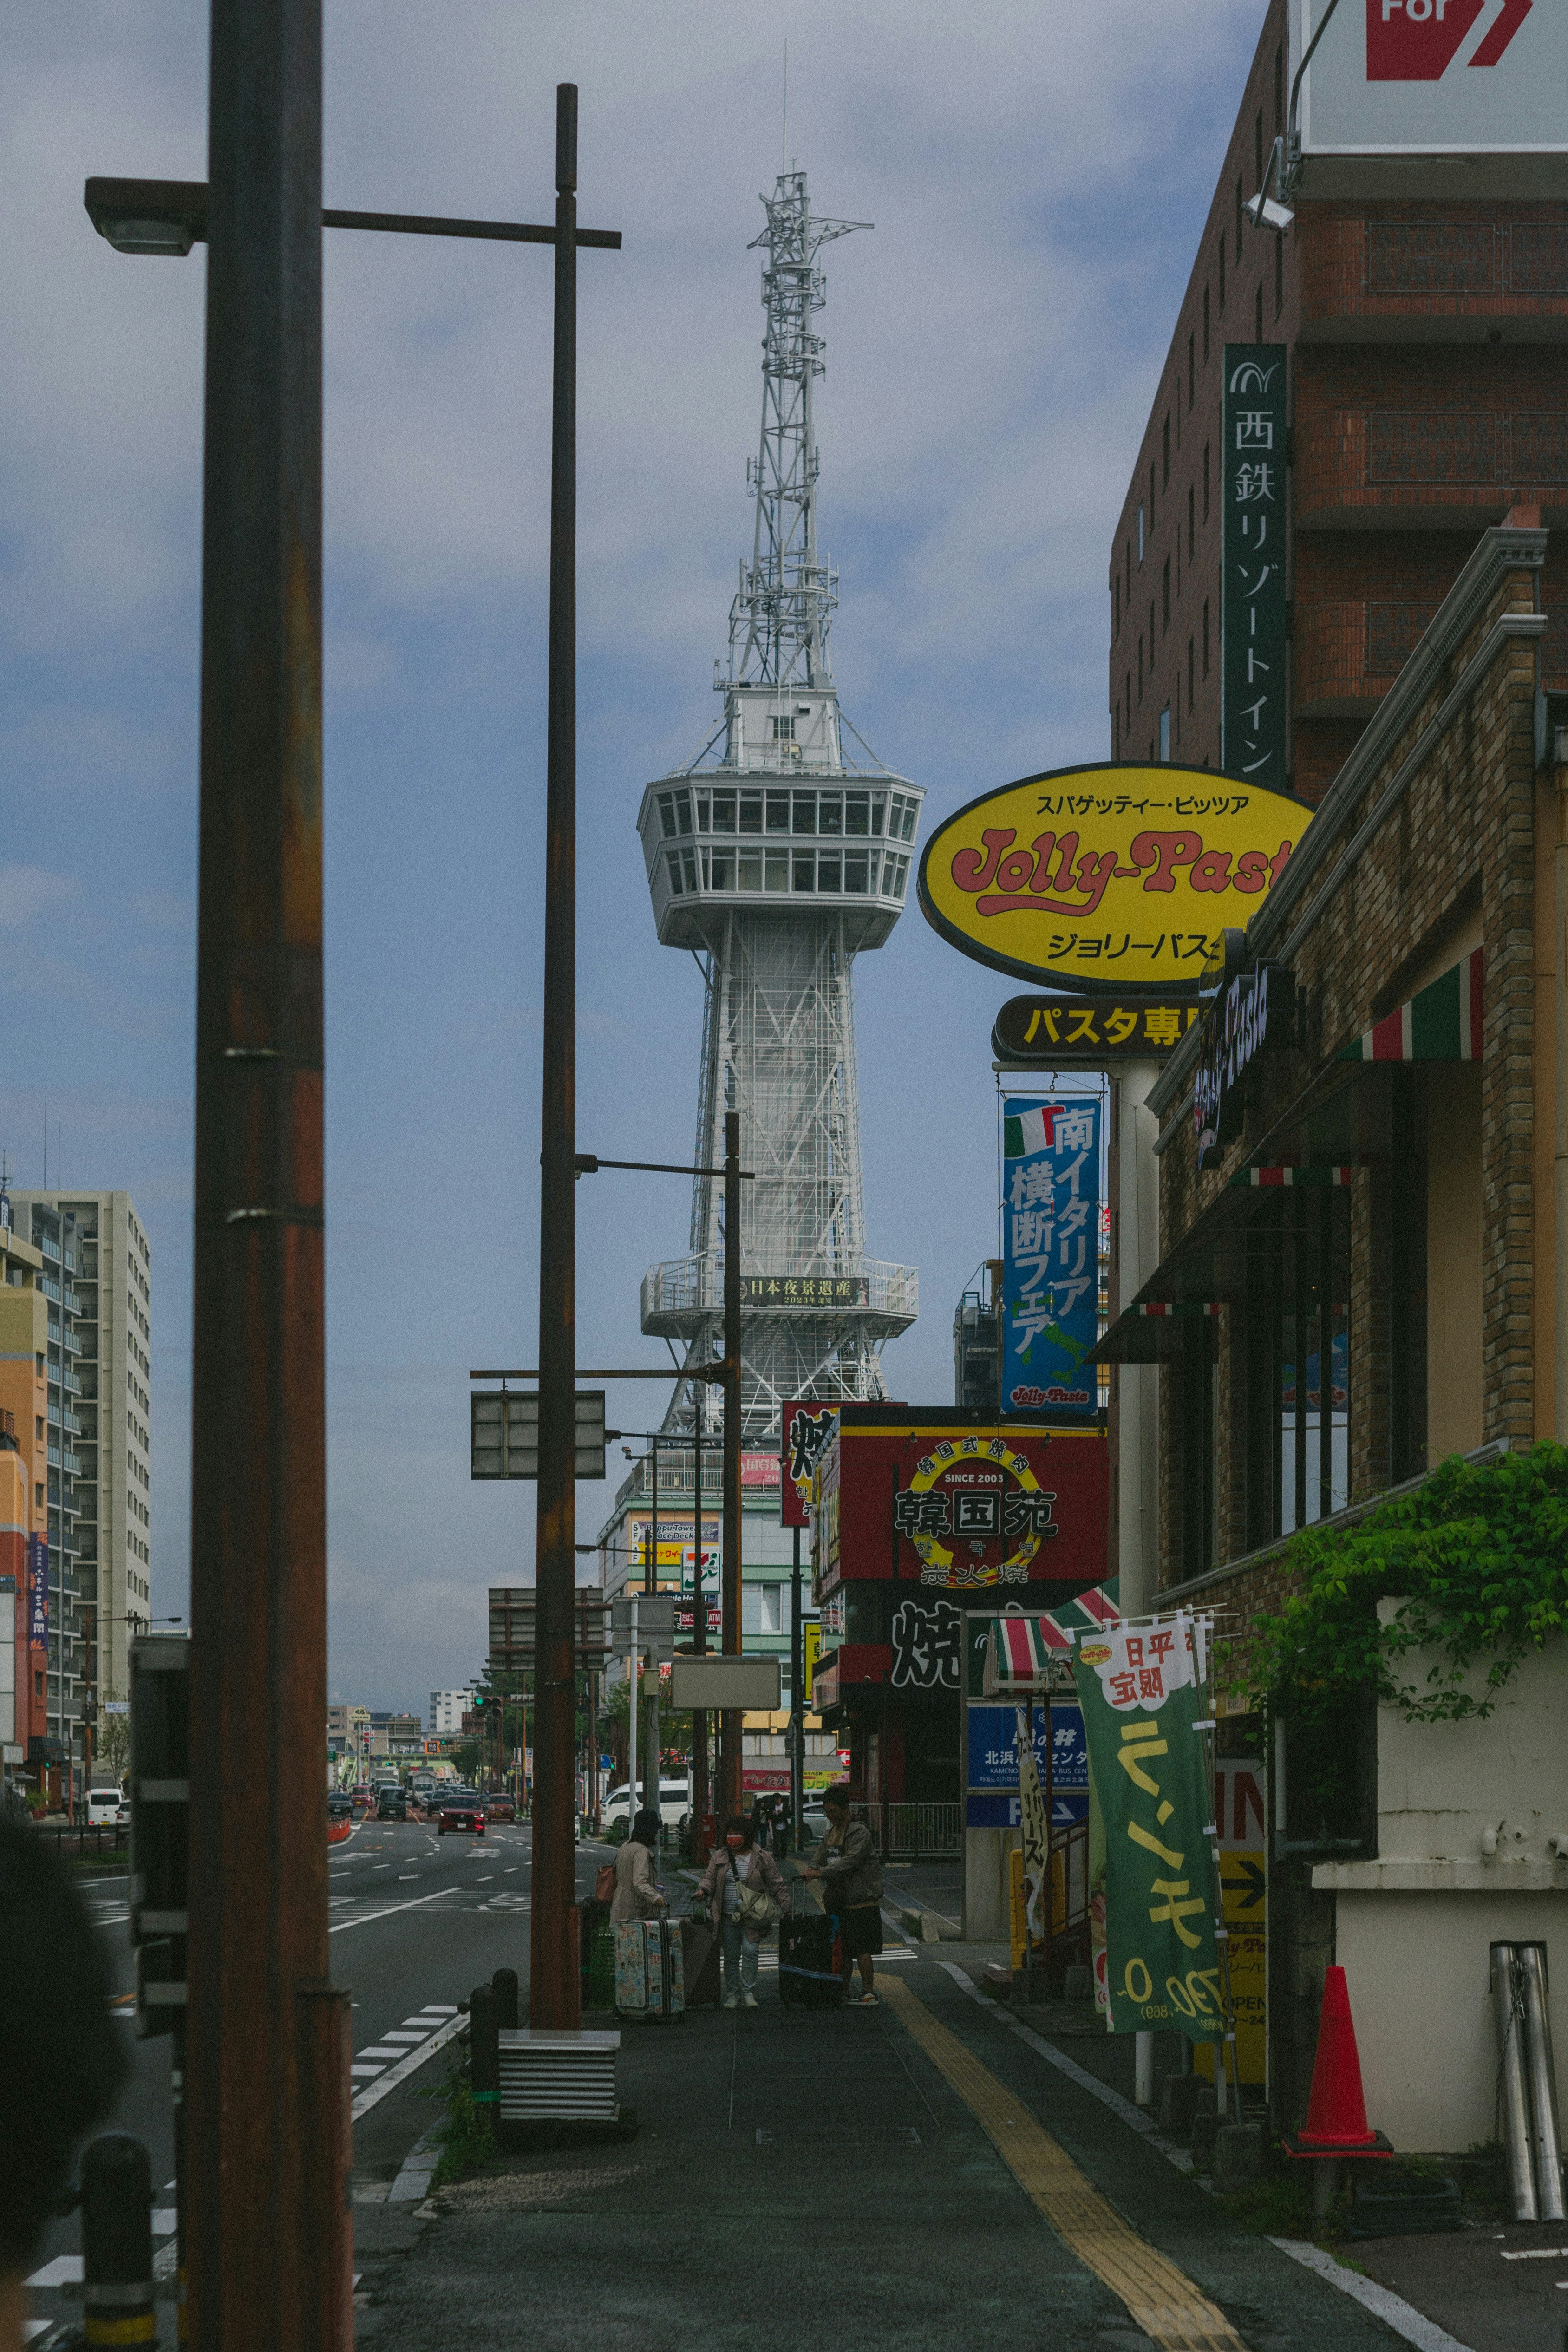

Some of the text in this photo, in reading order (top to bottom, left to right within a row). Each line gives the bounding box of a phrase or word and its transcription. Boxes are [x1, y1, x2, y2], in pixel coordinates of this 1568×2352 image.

[1235, 411, 1279, 773] 西鉄リゾートイン
[1053, 1108, 1096, 1317] 南イタリア
[1009, 1161, 1054, 1355] 横断フェア
[751, 1280, 851, 1296] 日本夜景遺産
[1011, 1386, 1088, 1407] Jolly-Pasta
[917, 1435, 1030, 1475] 韓国式焼肉
[945, 1474, 1004, 1483] SINCE 2003
[895, 1488, 1059, 1539] 韓国苑
[985, 1751, 1087, 1765] 北浜スセンタ
